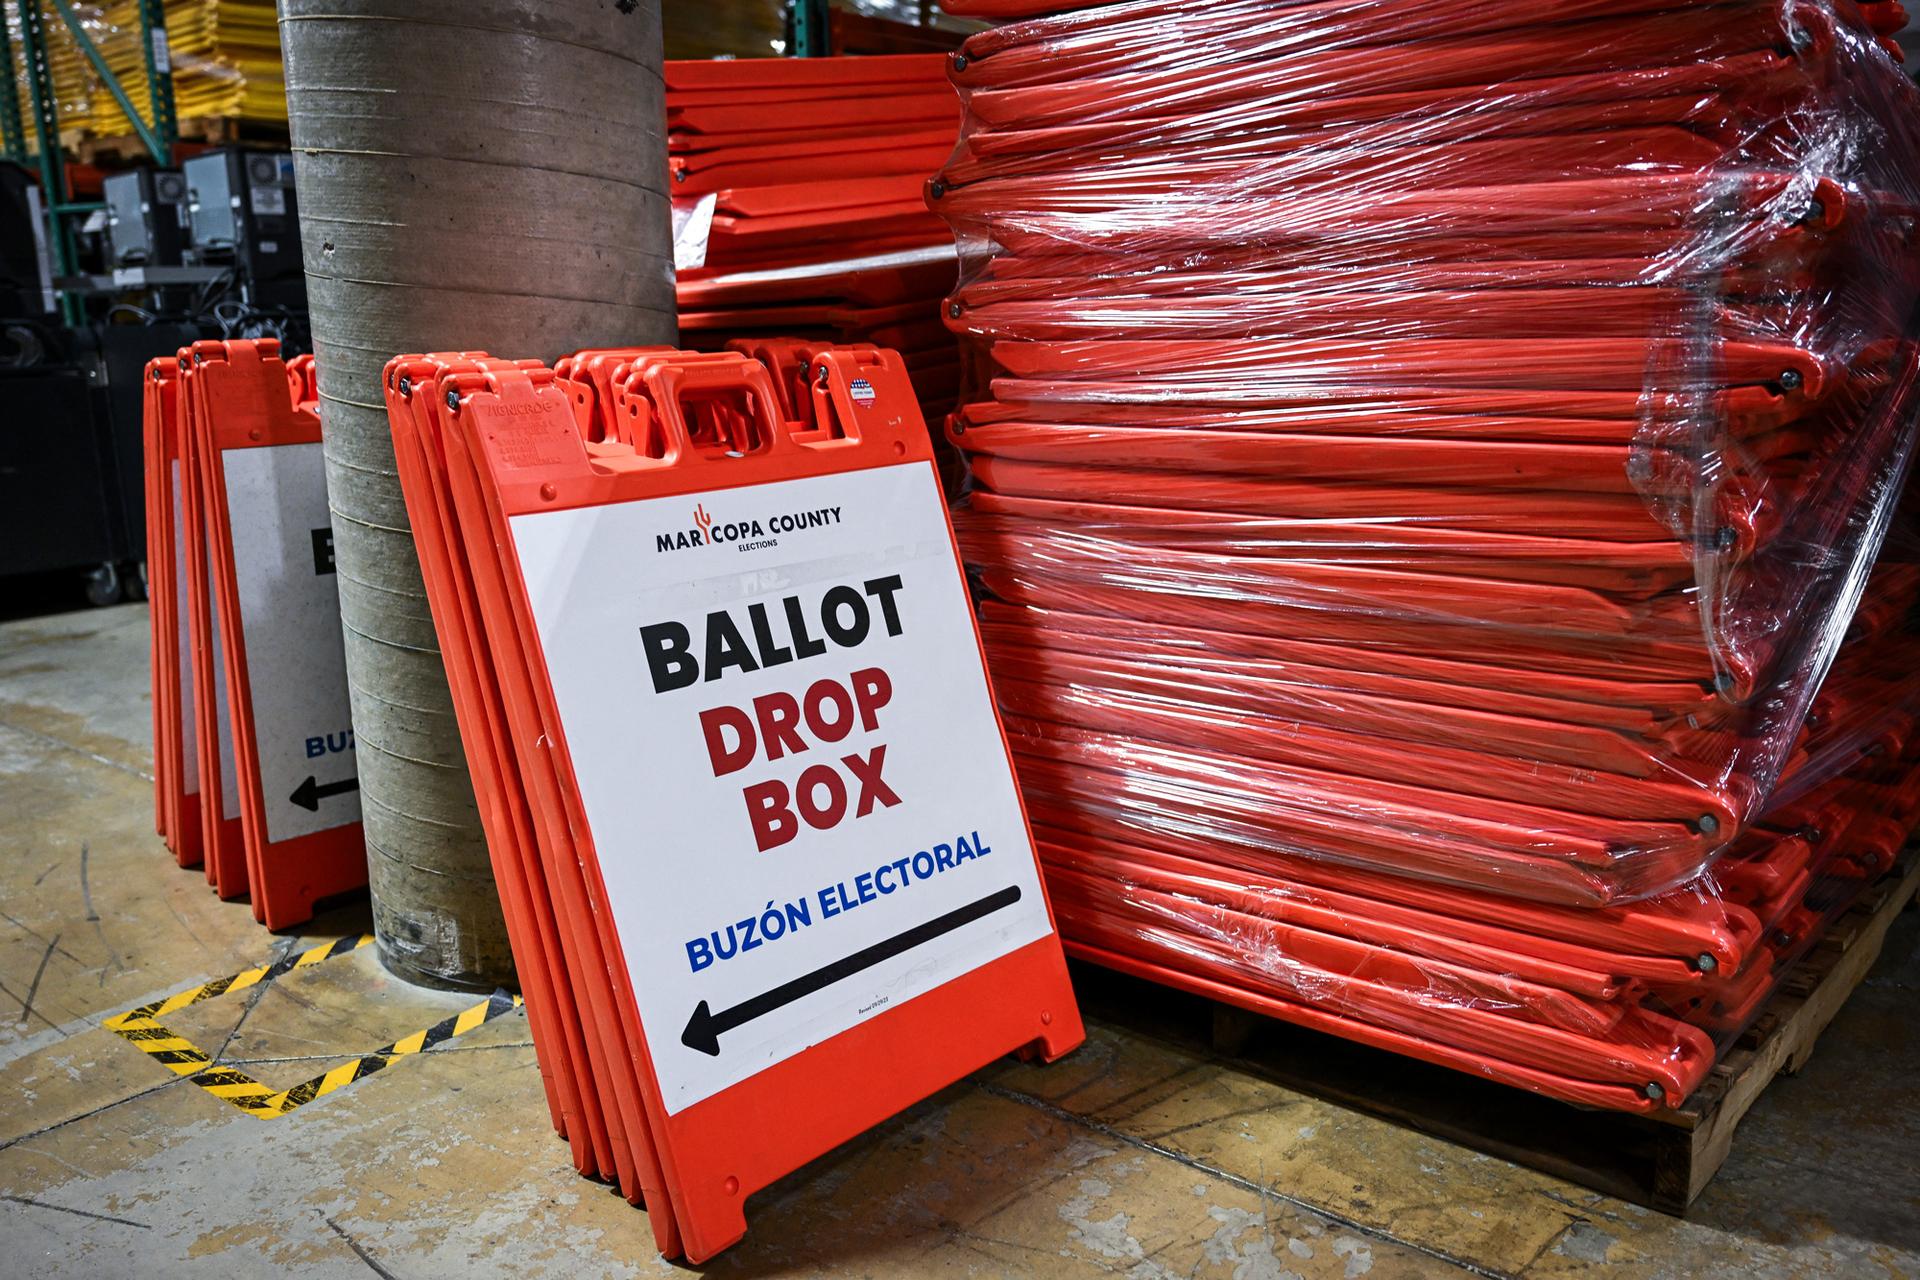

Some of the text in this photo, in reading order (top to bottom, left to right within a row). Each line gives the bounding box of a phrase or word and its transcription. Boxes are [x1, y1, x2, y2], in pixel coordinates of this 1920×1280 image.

[656, 504, 841, 552] MARICOPA COUNTY
[738, 539, 778, 552] ELECTIONS
[639, 574, 903, 694] BALLOT
[698, 667, 892, 778] DROP
[743, 744, 903, 853] BOX
[686, 831, 991, 973] BUZÓN ELECTORAL
